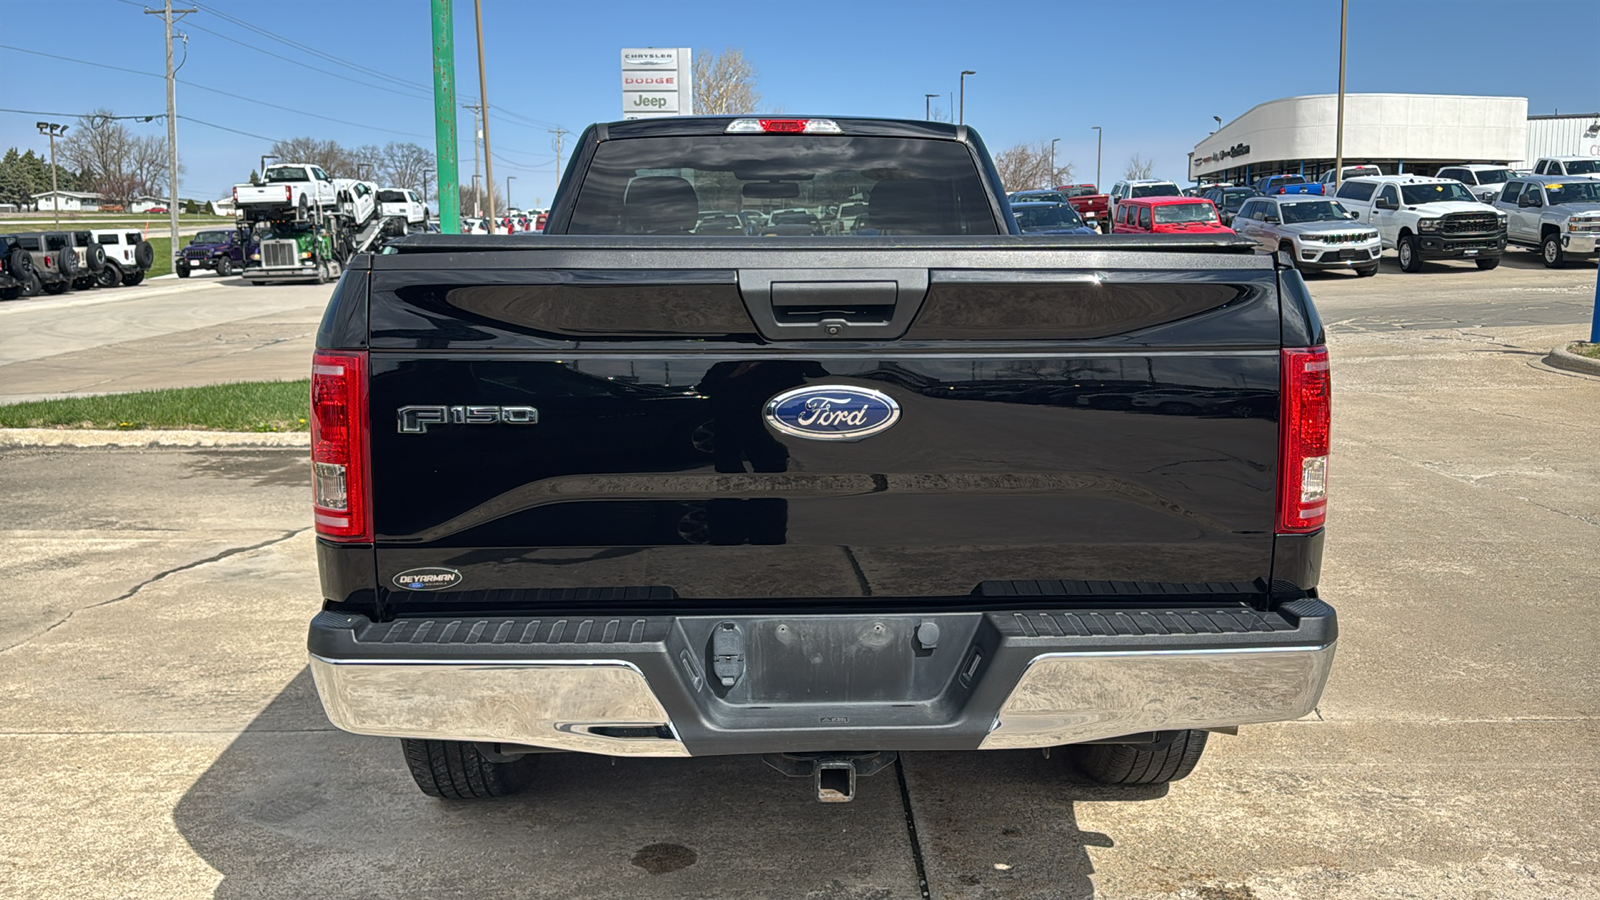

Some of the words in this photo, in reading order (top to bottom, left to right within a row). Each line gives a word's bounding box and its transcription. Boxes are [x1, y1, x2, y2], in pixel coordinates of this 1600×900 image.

[633, 95, 667, 108] Jeep
[797, 396, 869, 426] Ford
[399, 573, 456, 583] DEYARMAN
